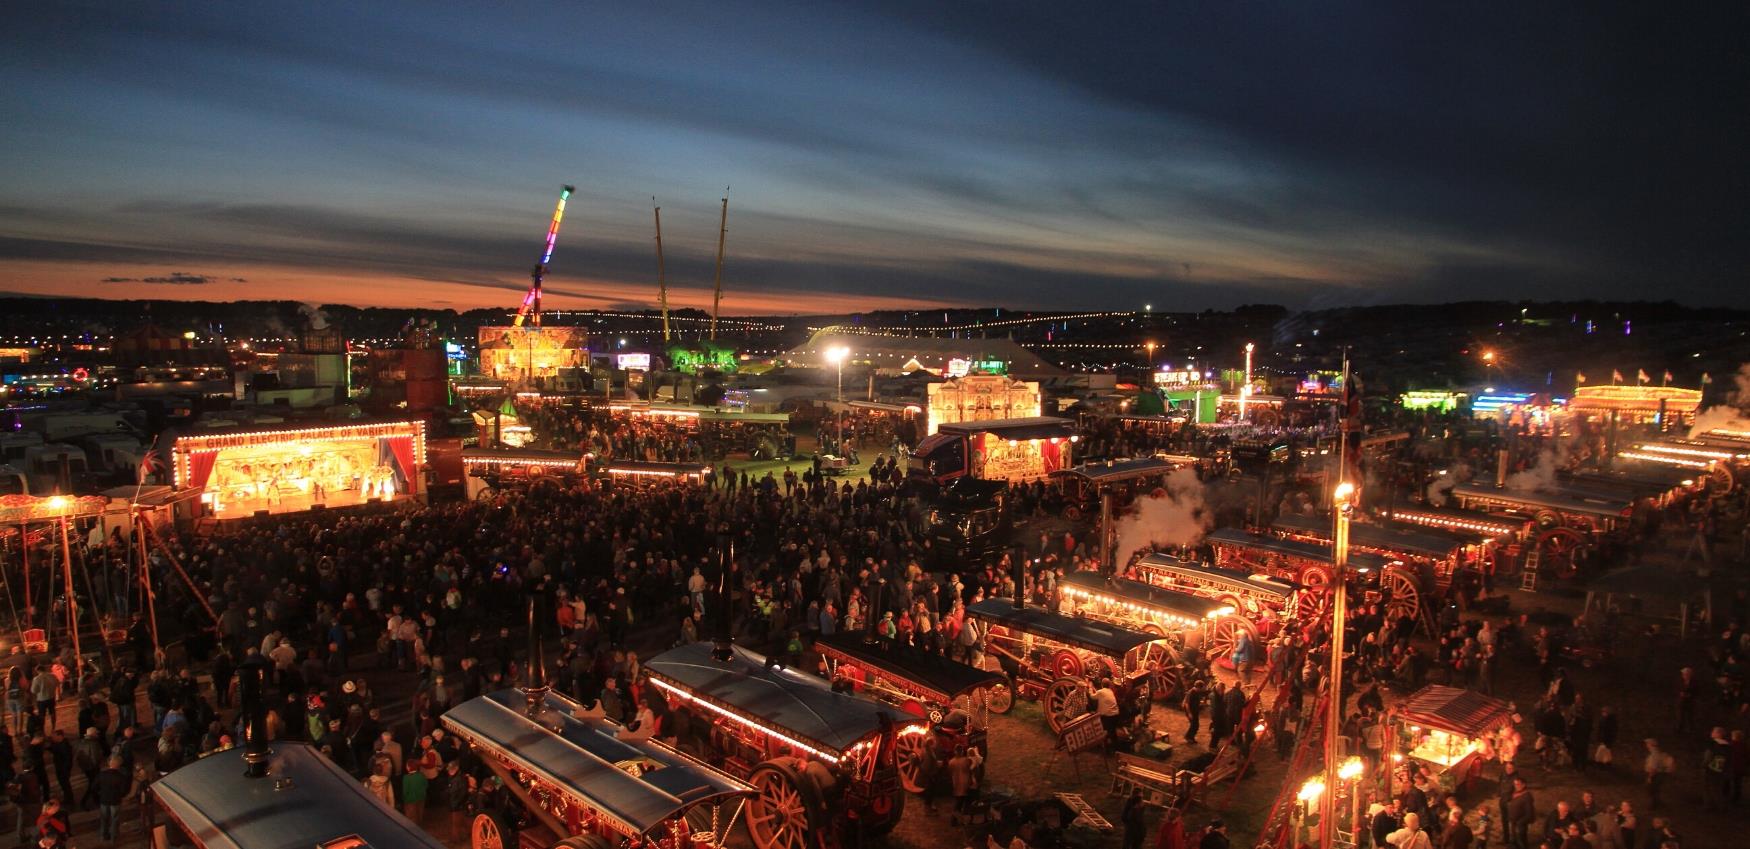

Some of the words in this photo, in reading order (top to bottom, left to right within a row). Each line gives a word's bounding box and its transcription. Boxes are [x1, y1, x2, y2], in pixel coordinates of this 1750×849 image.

[206, 437, 245, 449] GRAND
[250, 433, 295, 445] ELECTRIC
[300, 429, 334, 440] PALACE
[340, 429, 352, 437] OF
[356, 425, 396, 437] VARIETY
[909, 682, 946, 702] RAILWAY
[596, 807, 634, 838] RAILWAY
